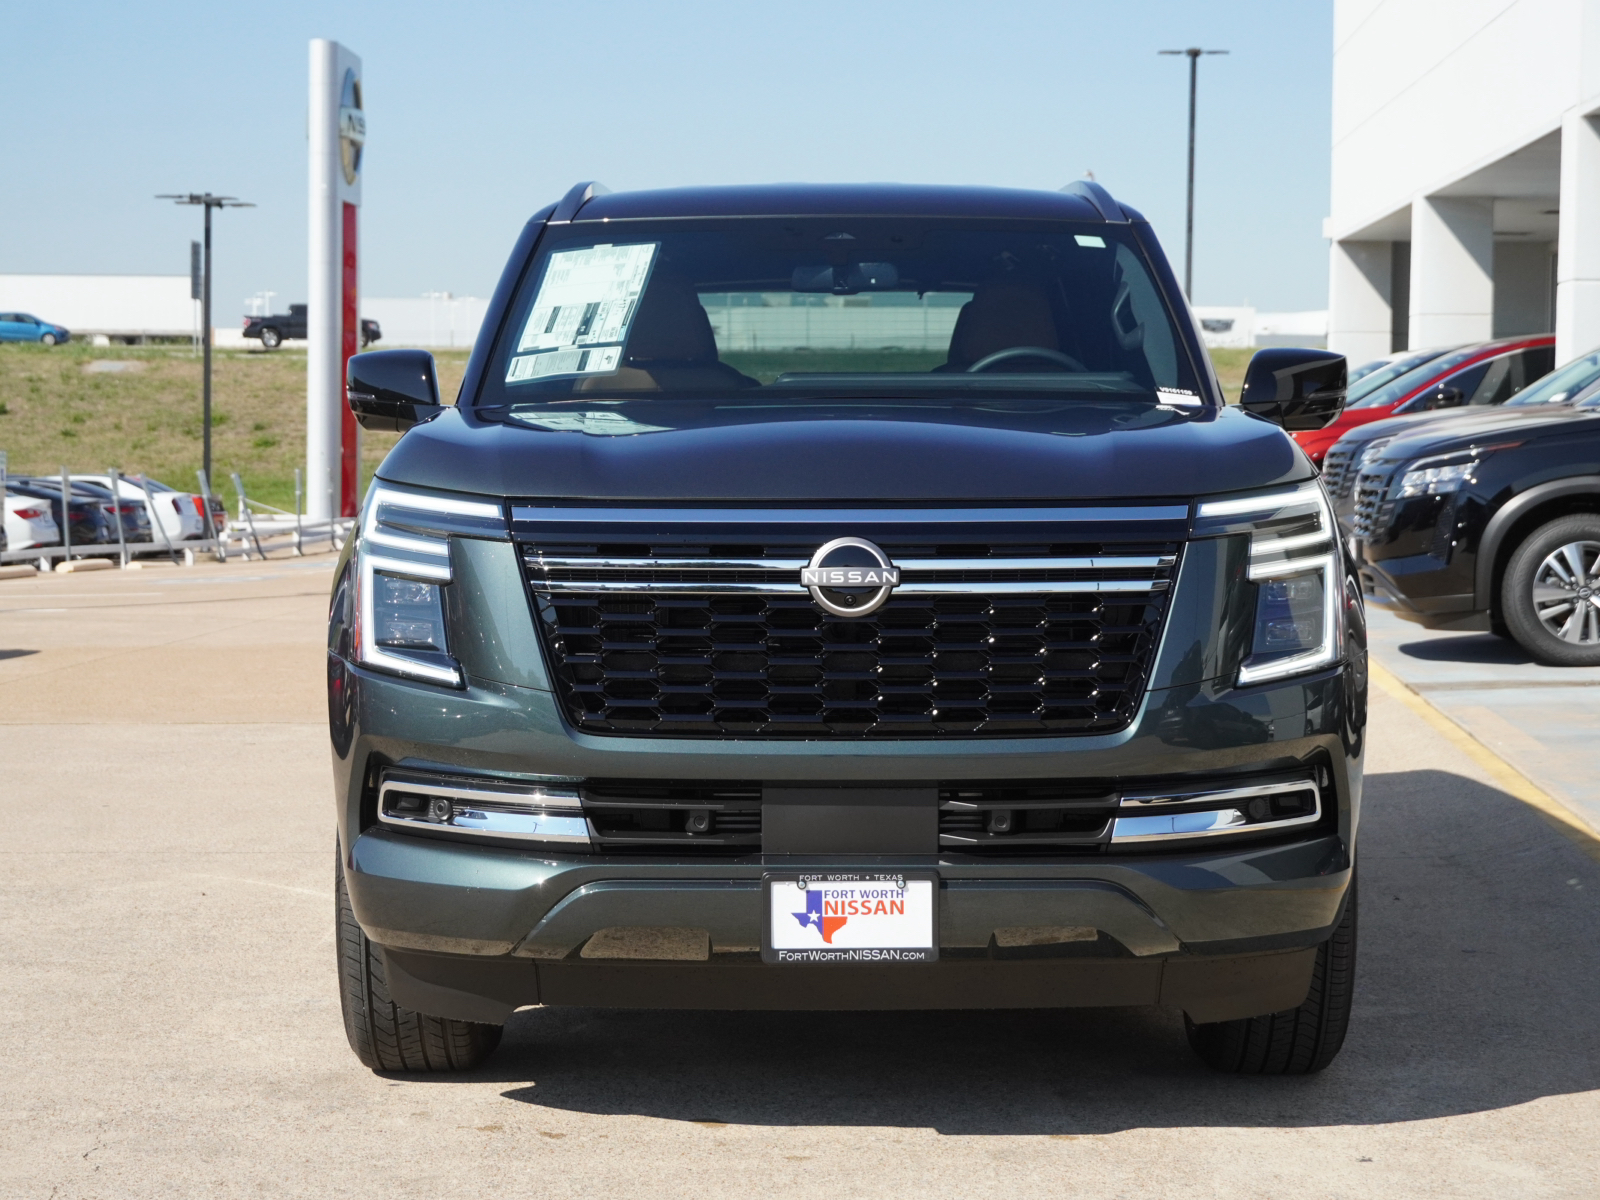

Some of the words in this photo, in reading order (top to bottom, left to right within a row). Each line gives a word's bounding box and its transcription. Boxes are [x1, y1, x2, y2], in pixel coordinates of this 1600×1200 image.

[804, 571, 897, 583] NISSAN
[824, 890, 856, 899] FORT
[860, 889, 904, 899] WORTH
[824, 900, 904, 915] NISSAN
